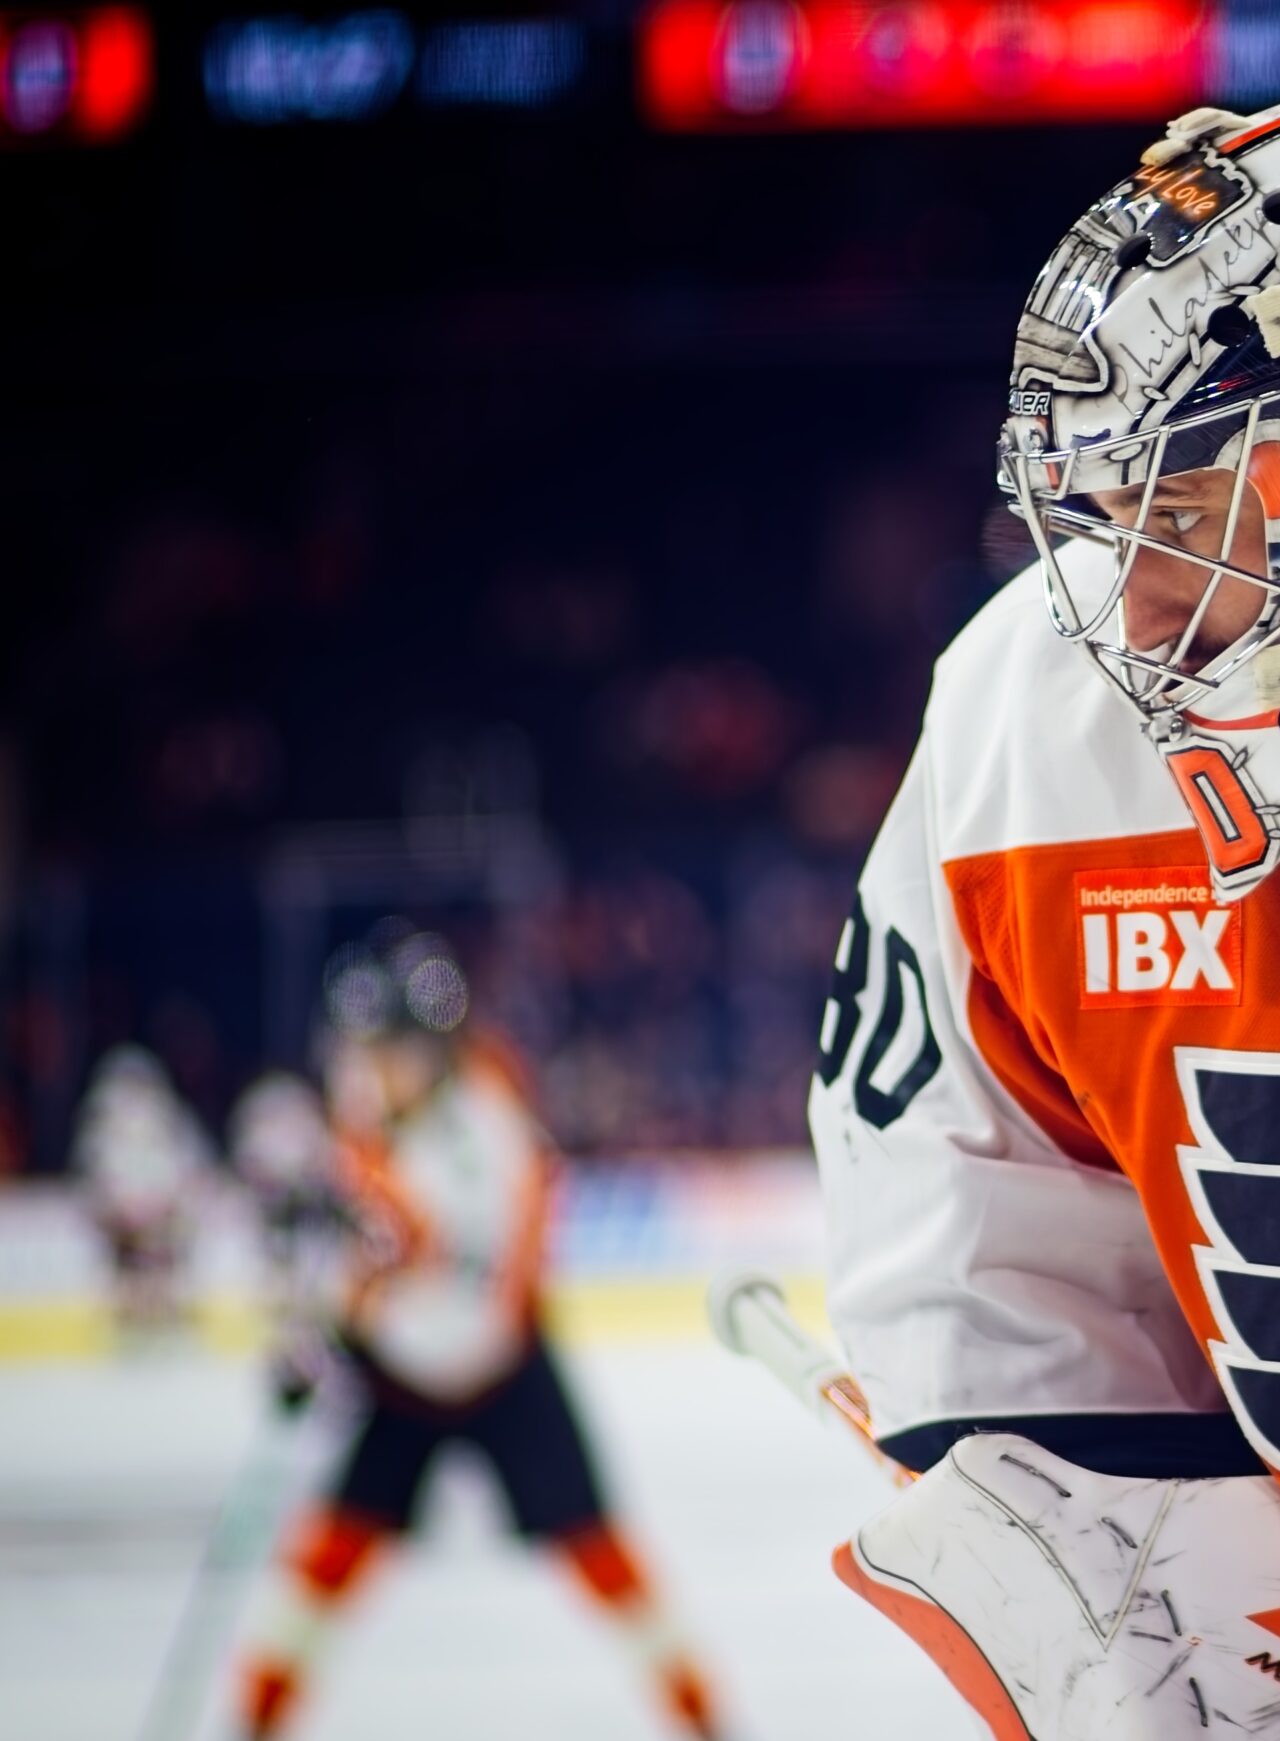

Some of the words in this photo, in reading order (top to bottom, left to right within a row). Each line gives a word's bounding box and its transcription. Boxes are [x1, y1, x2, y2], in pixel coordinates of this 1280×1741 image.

[1009, 391, 1050, 416] UER
[1080, 884, 1208, 909] Independence
[1082, 909, 1235, 994] IBX
